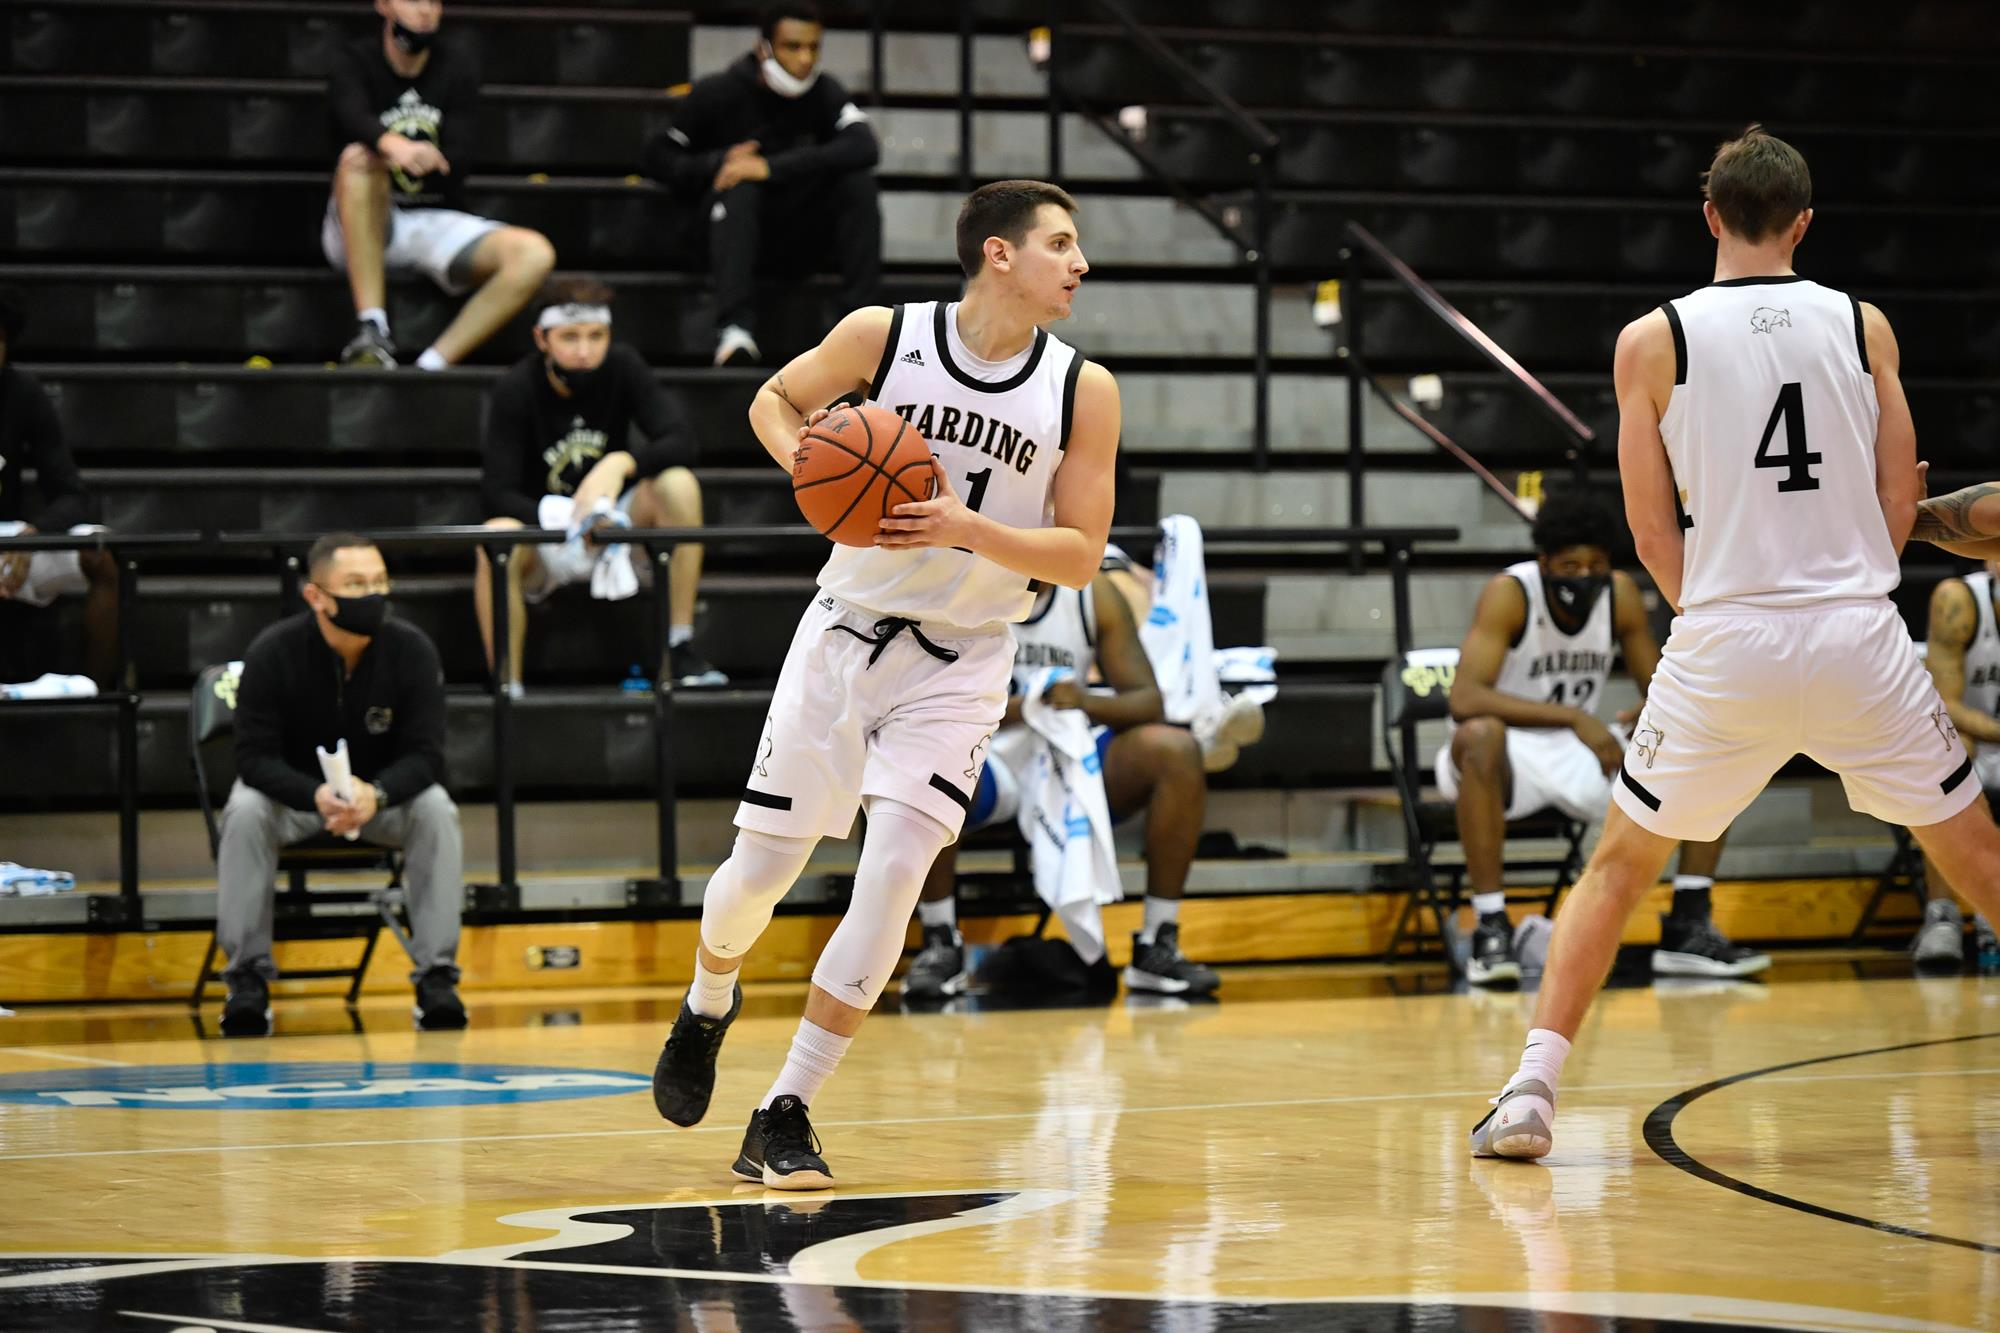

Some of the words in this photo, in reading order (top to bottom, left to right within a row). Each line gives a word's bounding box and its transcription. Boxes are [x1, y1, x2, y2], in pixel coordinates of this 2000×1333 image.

[900, 356, 925, 367] adidas
[1754, 377, 1822, 492] 4
[37, 1073, 653, 1105] NCAA
